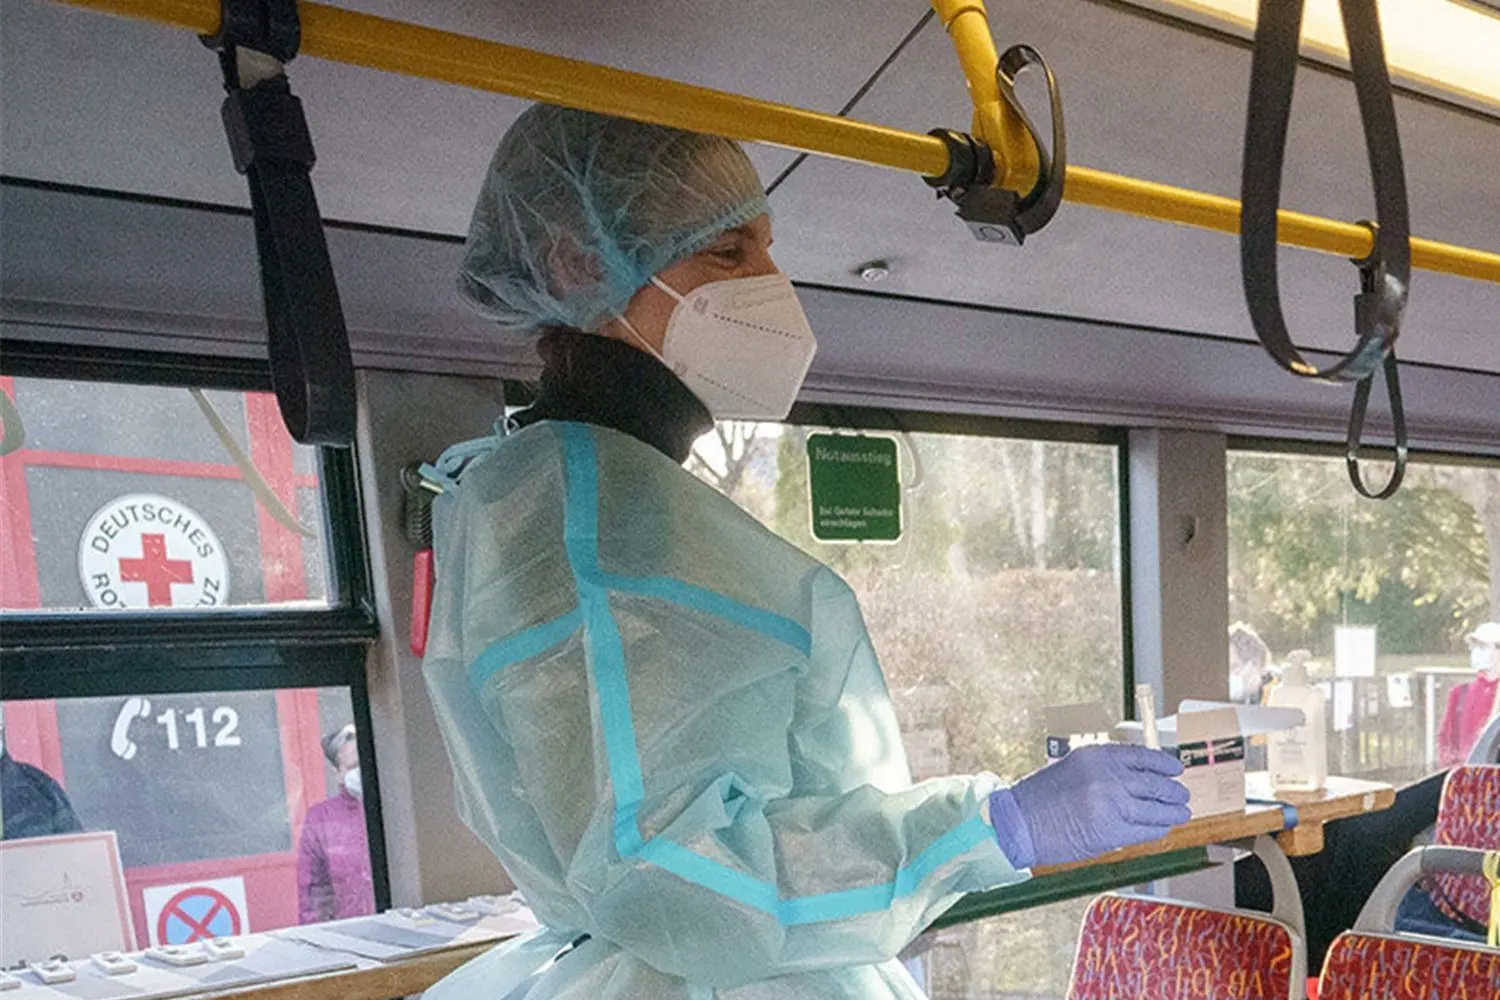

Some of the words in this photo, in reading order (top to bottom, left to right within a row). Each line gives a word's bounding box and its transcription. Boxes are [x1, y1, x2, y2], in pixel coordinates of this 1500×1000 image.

[815, 446, 893, 468] Notausstieg
[91, 503, 214, 558] DEUTSCHES
[157, 706, 242, 750] 112
